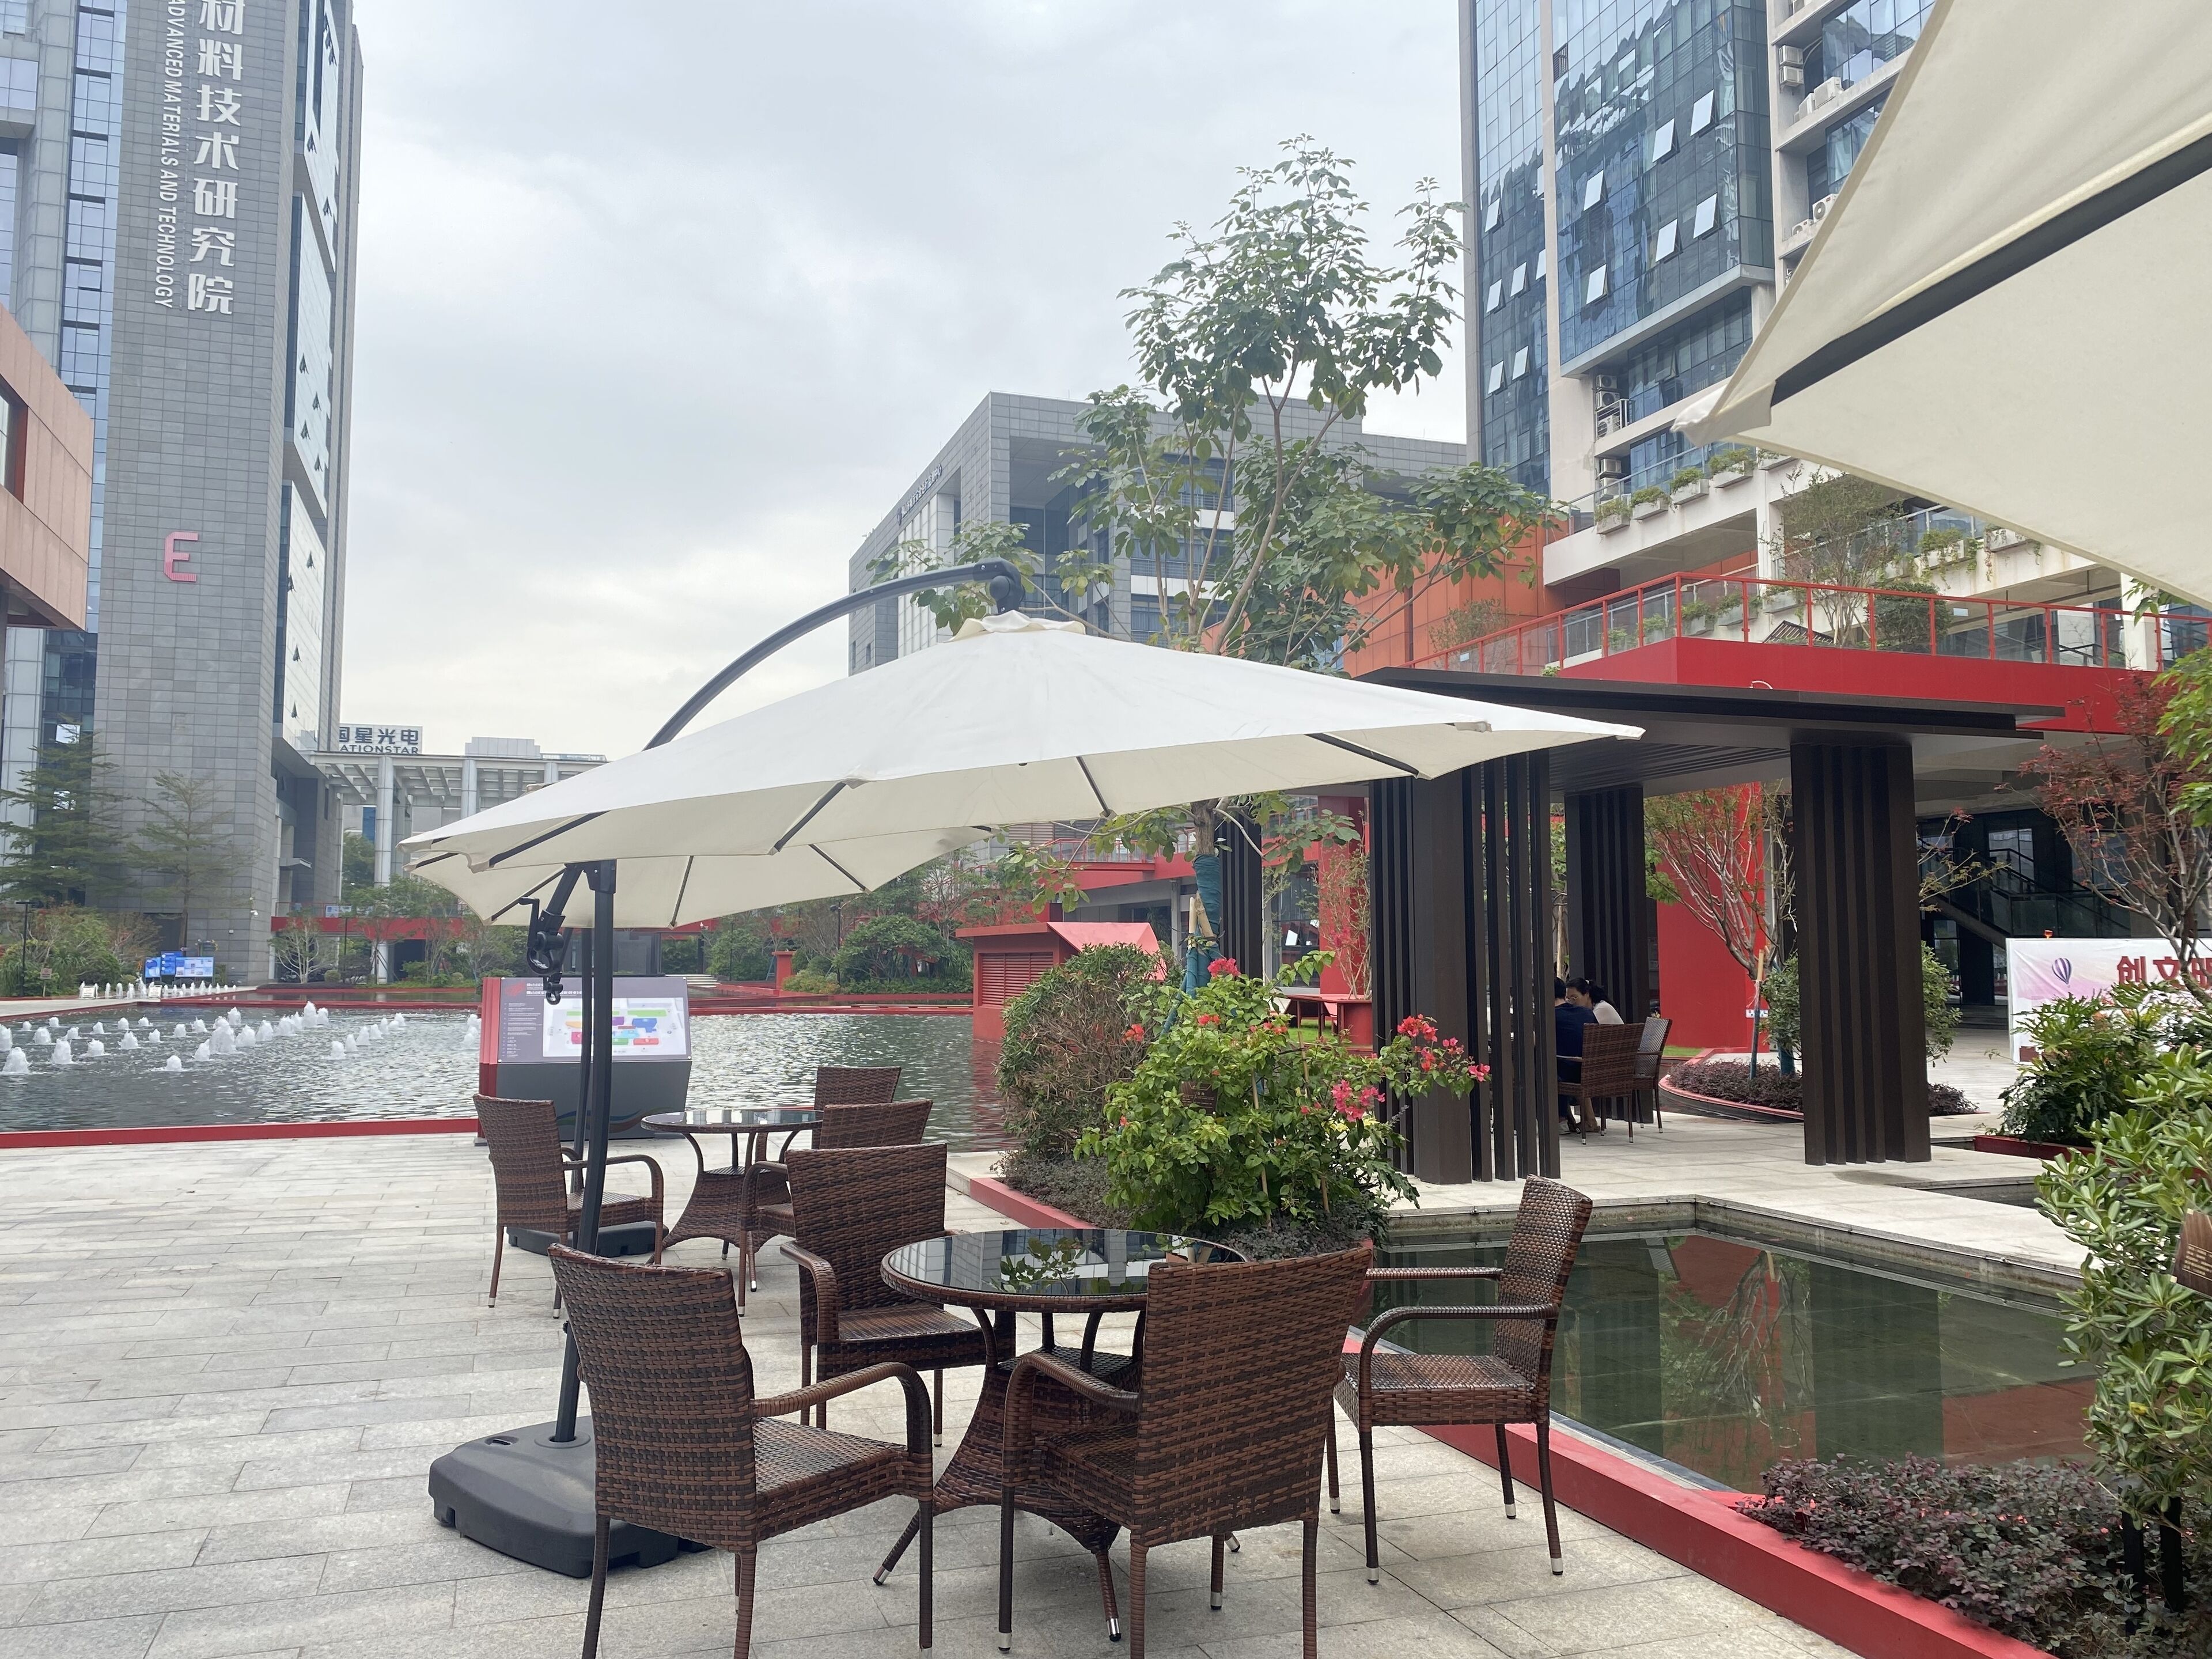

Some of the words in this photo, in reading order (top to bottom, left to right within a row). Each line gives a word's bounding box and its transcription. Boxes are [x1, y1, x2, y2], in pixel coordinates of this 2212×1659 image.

[161, 80, 182, 166] MATERIALS
[188, 0, 244, 315] 材料技术研究院
[160, 169, 179, 201] AND
[154, 207, 177, 308] TECHNOLOGY
[164, 531, 198, 582] E
[339, 726, 418, 745] 国星光电
[340, 744, 419, 755] ATIONSTAR
